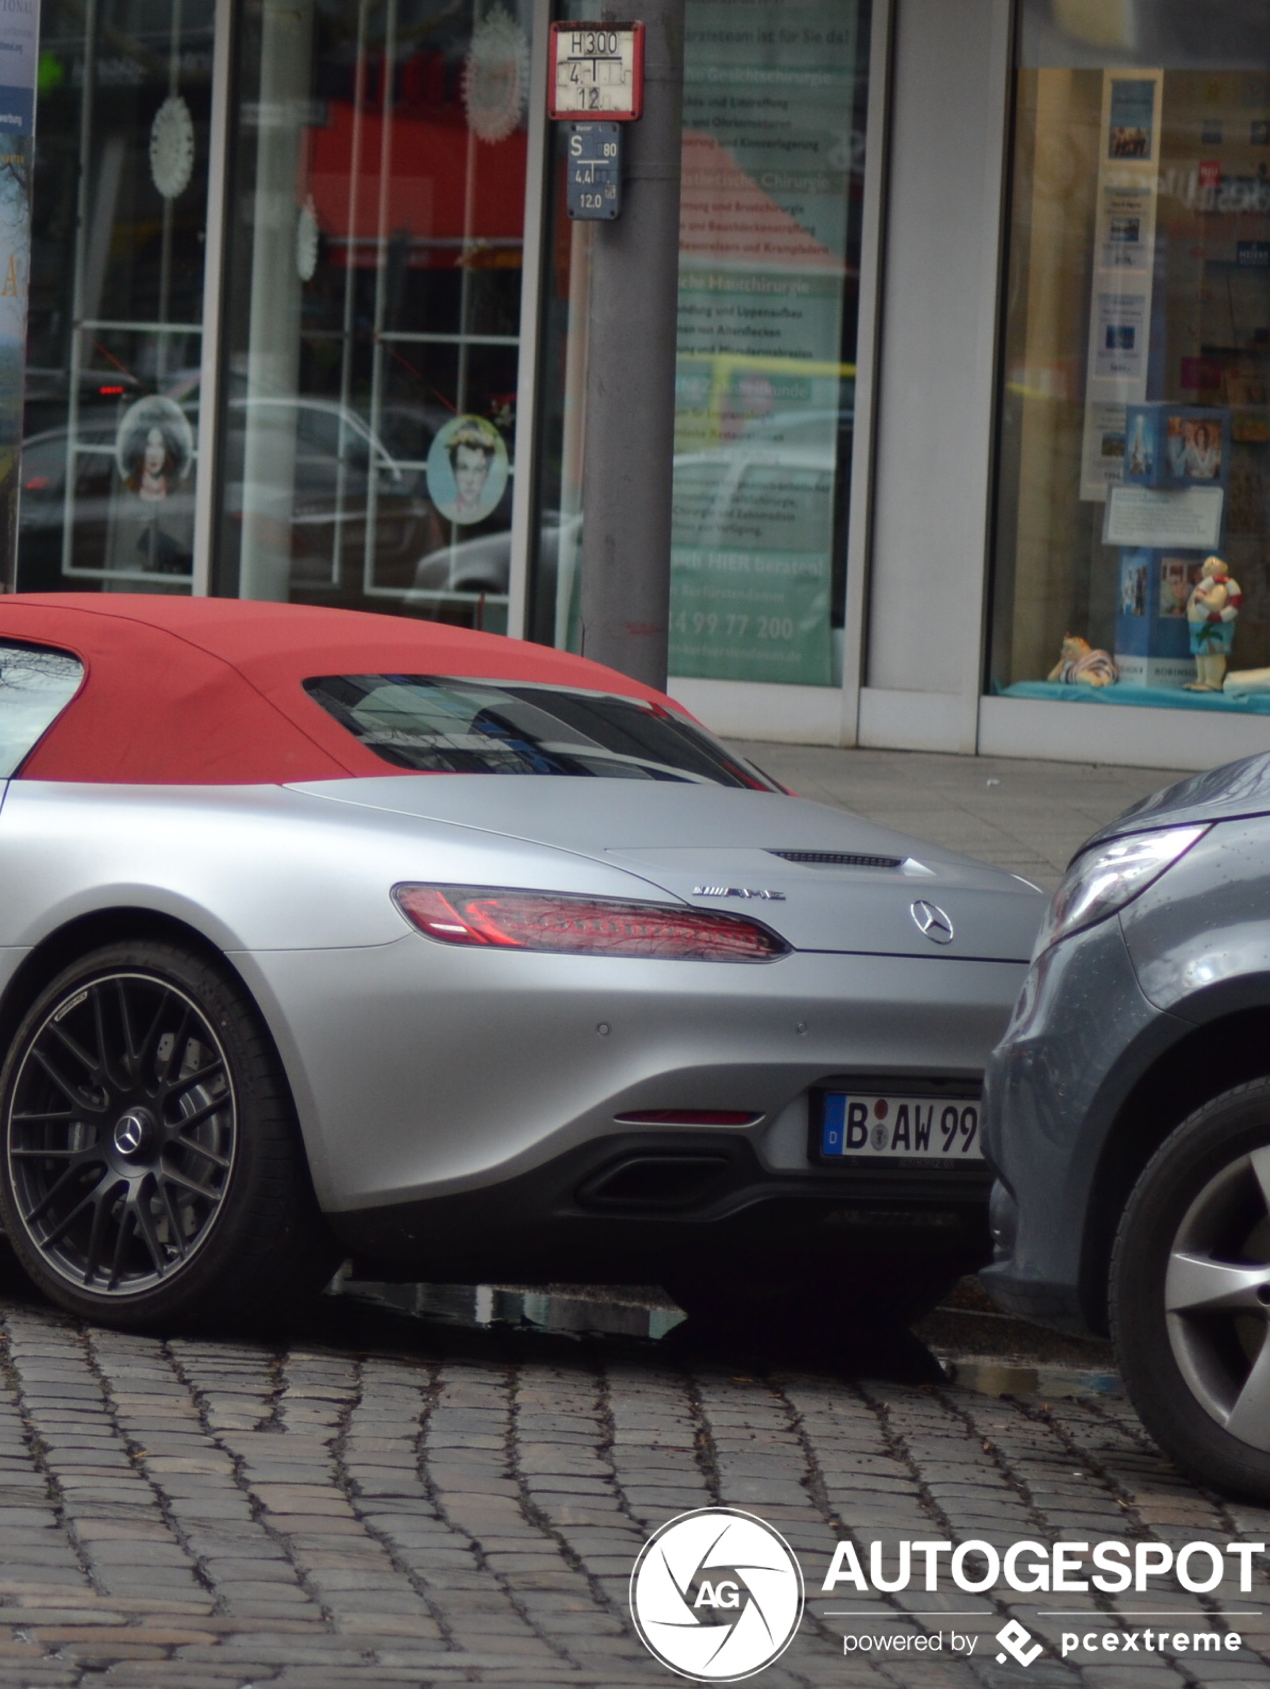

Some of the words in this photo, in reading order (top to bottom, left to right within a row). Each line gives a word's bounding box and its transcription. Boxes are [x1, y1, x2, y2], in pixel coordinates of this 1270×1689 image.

[570, 135, 583, 157] S
[603, 143, 617, 157] 80
[575, 169, 592, 185] 4.4
[761, 173, 830, 192] Chirurgie
[580, 194, 602, 209] 12.0
[708, 274, 810, 297] Hautchirurgie
[708, 552, 751, 571] HIER
[754, 553, 824, 577] beraten!
[692, 611, 719, 635] 99
[726, 613, 750, 637] 77
[756, 615, 794, 640] 200
[829, 1131, 837, 1144] D
[846, 1102, 869, 1149] B
[891, 1103, 934, 1151] AW
[940, 1105, 979, 1153] 99
